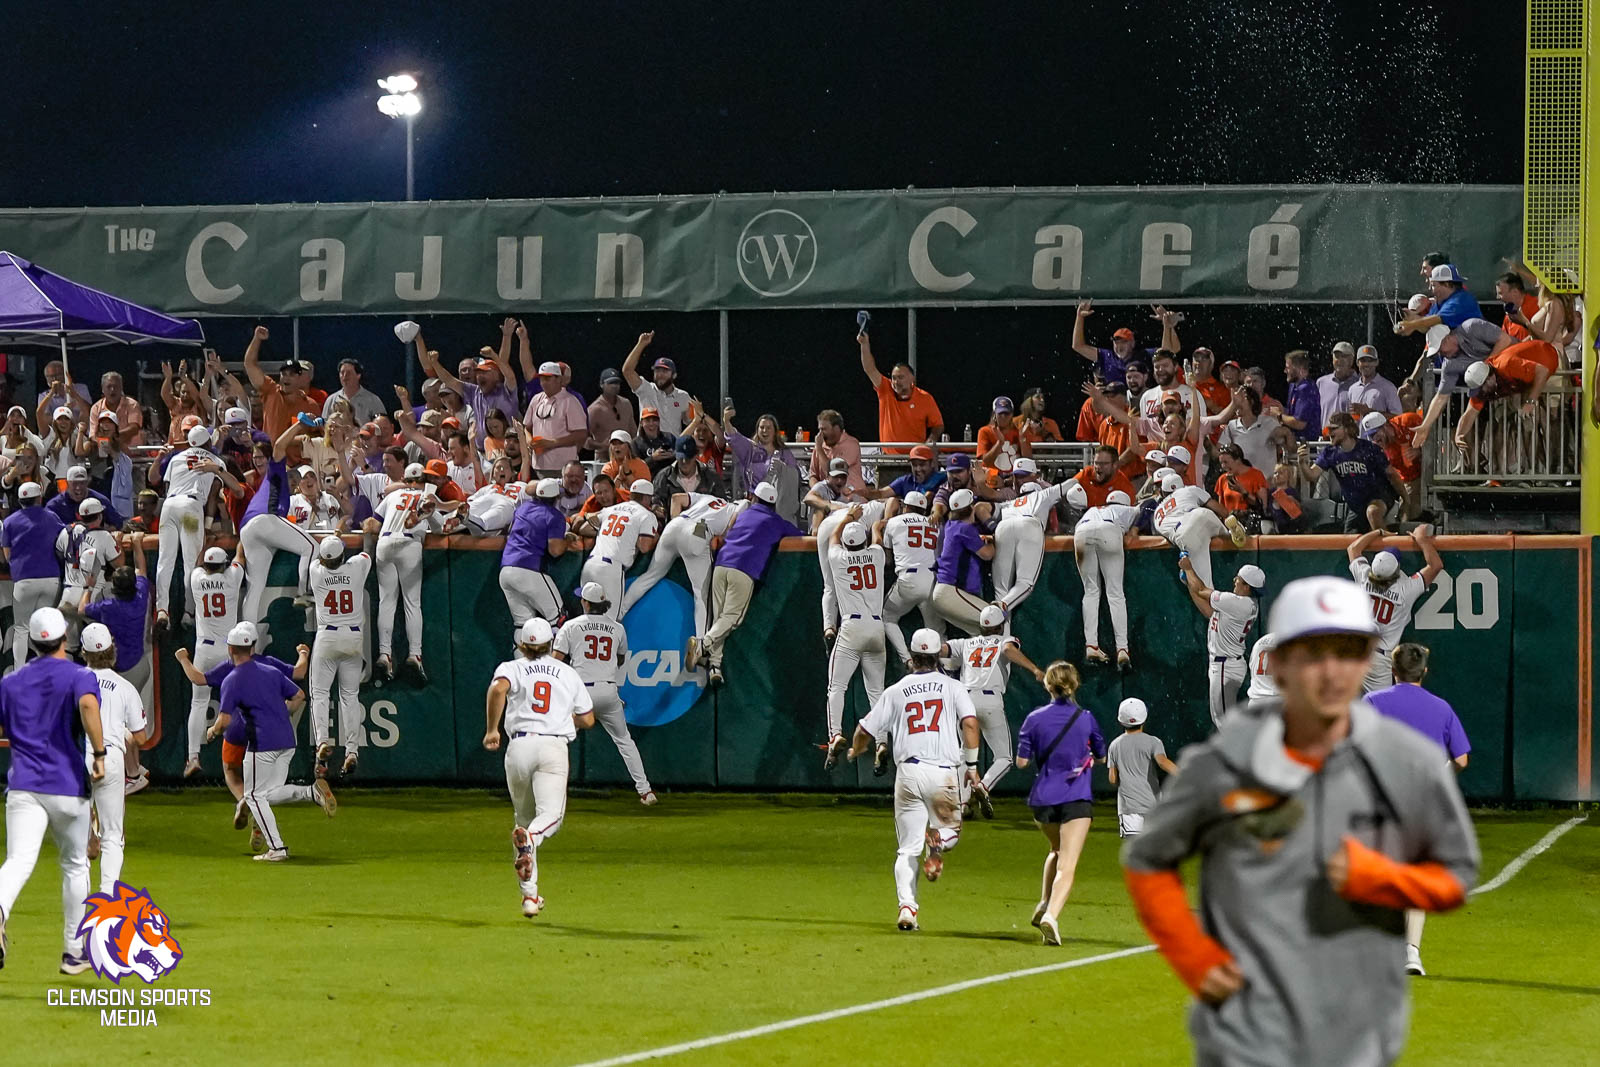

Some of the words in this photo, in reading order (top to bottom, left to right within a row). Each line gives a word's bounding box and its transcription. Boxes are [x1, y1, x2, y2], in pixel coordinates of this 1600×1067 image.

[741, 234, 809, 281] W
[1336, 461, 1367, 477] TIGERS
[396, 493, 421, 512] 31
[601, 514, 630, 538] 36
[907, 526, 939, 550] 55
[847, 554, 873, 565] BARLOW
[201, 580, 225, 591] KNAAK
[324, 575, 351, 586] HUGHES
[847, 564, 877, 590] 30
[201, 593, 226, 618] 19
[323, 589, 353, 615] 48
[584, 635, 613, 661] 33
[968, 647, 999, 668] 47
[525, 664, 561, 679] JARRELL
[531, 680, 552, 714] 9
[903, 682, 943, 698] BISSETTA
[905, 698, 943, 735] 27
